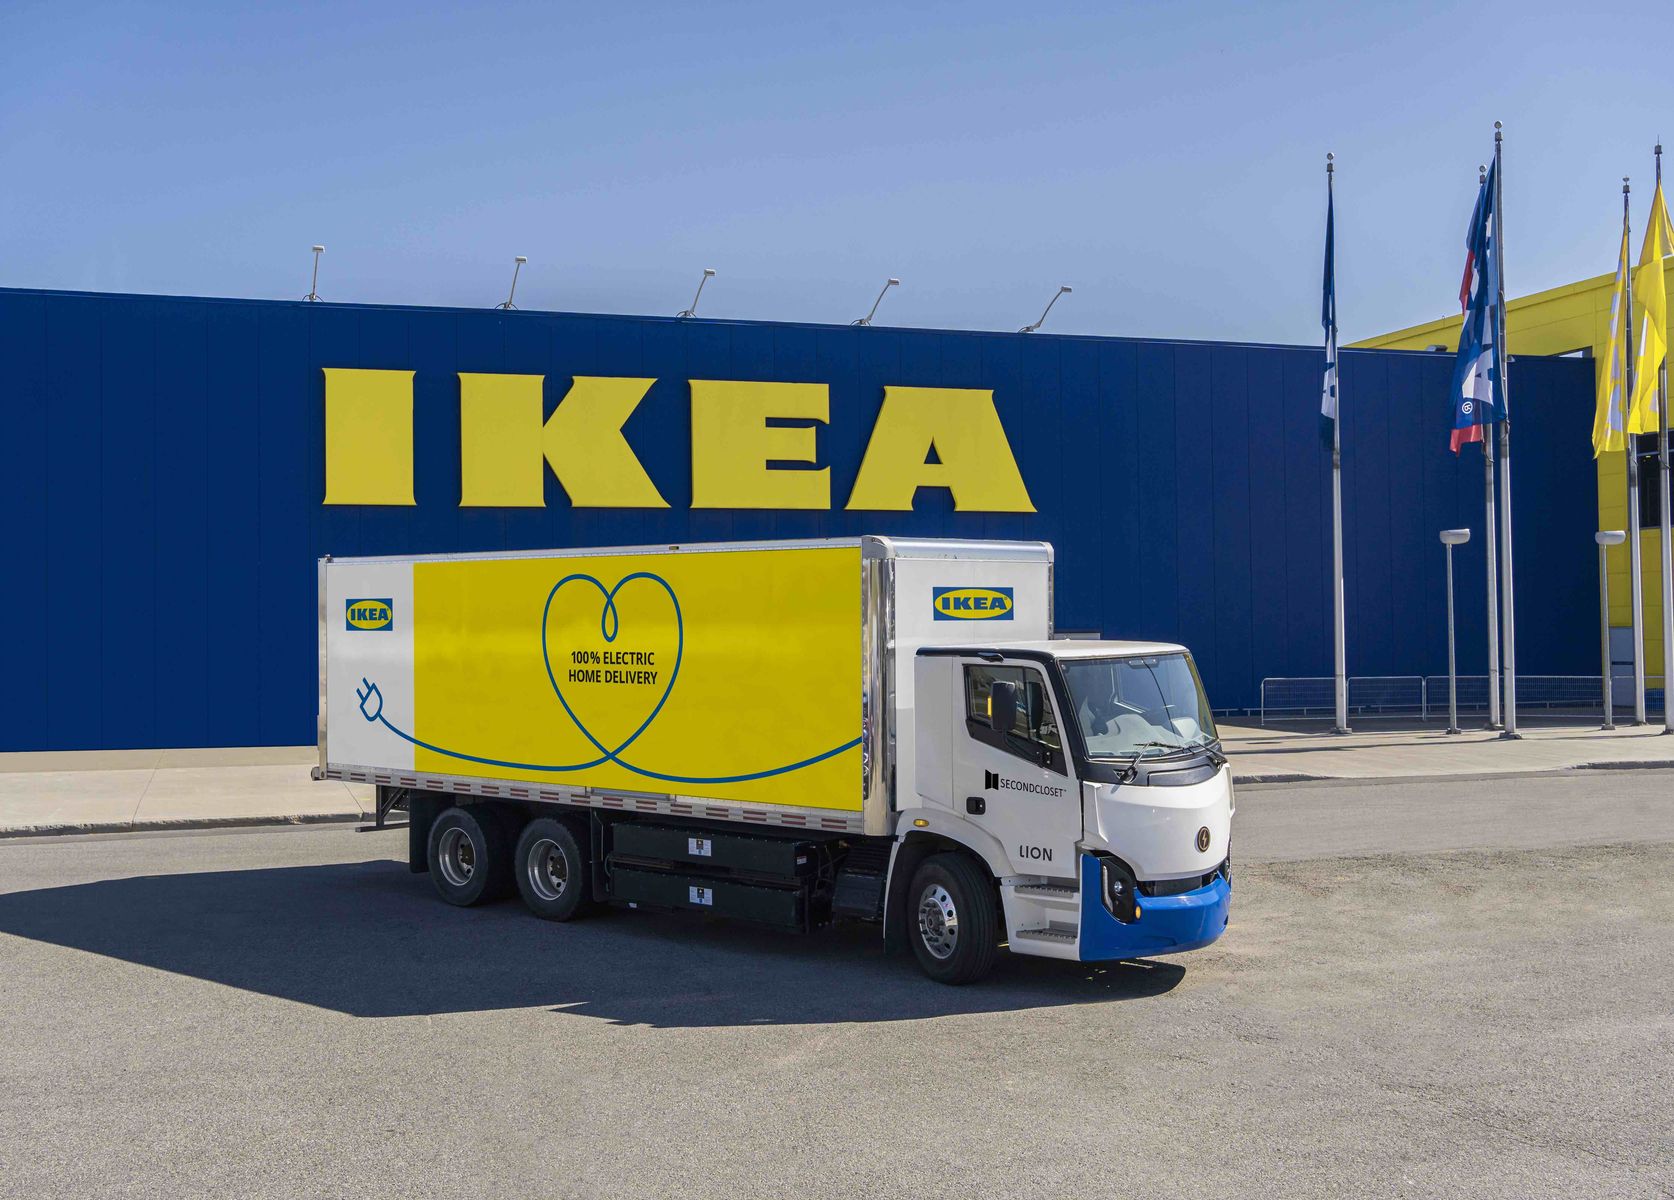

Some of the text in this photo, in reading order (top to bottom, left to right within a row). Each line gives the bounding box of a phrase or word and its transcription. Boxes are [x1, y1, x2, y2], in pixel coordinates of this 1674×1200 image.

[321, 367, 1039, 513] IKEA
[941, 597, 1008, 610] IKEA
[350, 607, 389, 621] IKEA
[571, 651, 655, 666] 100% ELECTRIC
[568, 669, 658, 685] HOME DELIVERY
[1000, 778, 1064, 798] SECONDCLOSET
[1019, 845, 1053, 861] LION
